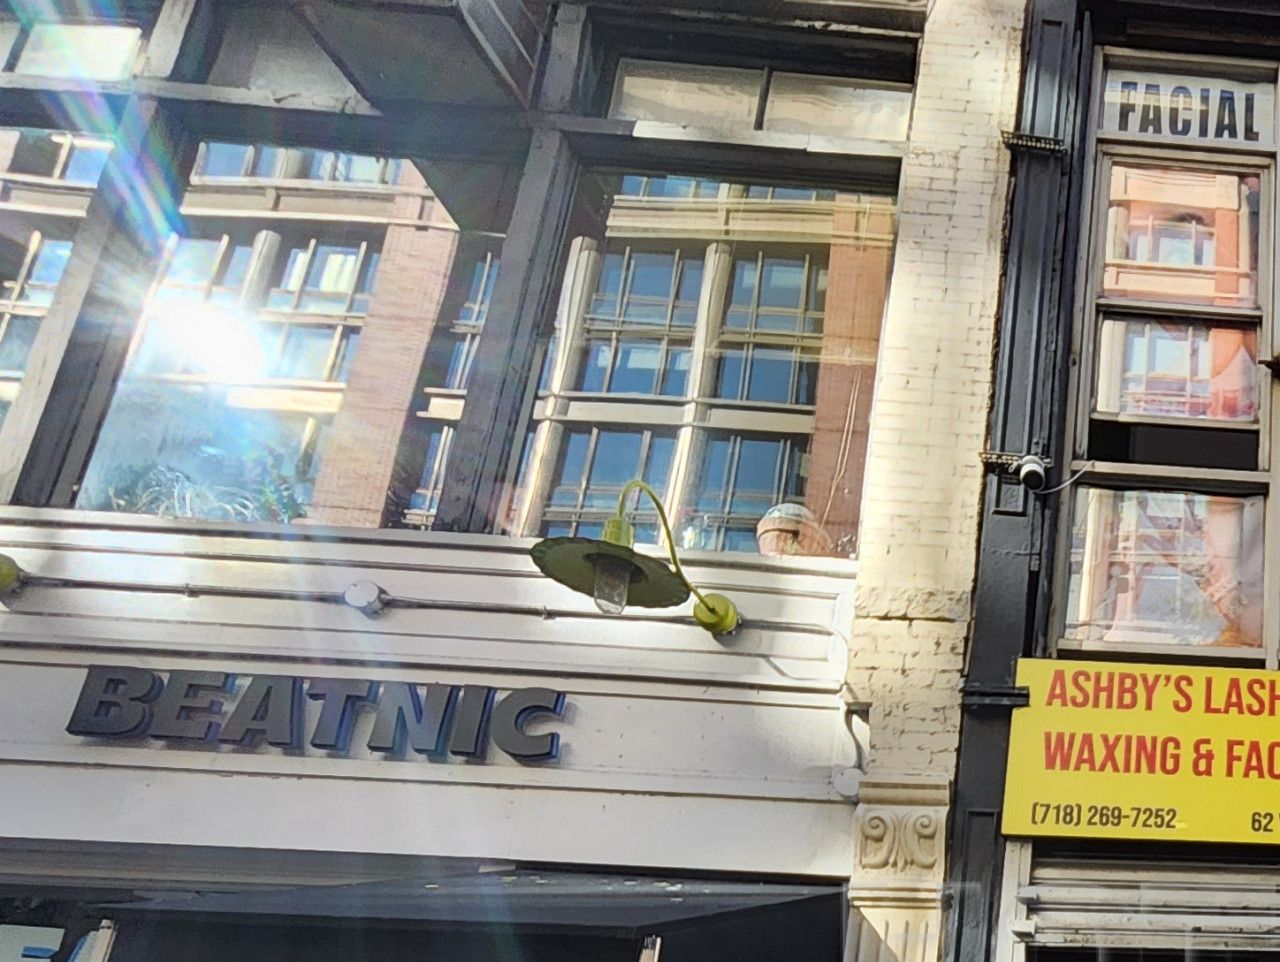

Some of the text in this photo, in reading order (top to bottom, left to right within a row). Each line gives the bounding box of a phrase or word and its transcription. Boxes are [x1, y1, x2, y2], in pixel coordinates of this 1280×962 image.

[1118, 79, 1259, 141] FACIAL
[1046, 669, 1193, 713] ASHBY'S
[66, 664, 567, 765] BEATNIC
[1043, 731, 1181, 776] WAXING
[1192, 738, 1215, 777] &
[1031, 802, 1083, 828] (718)
[1087, 804, 1178, 830] 269-7252
[1251, 812, 1274, 833] 62
